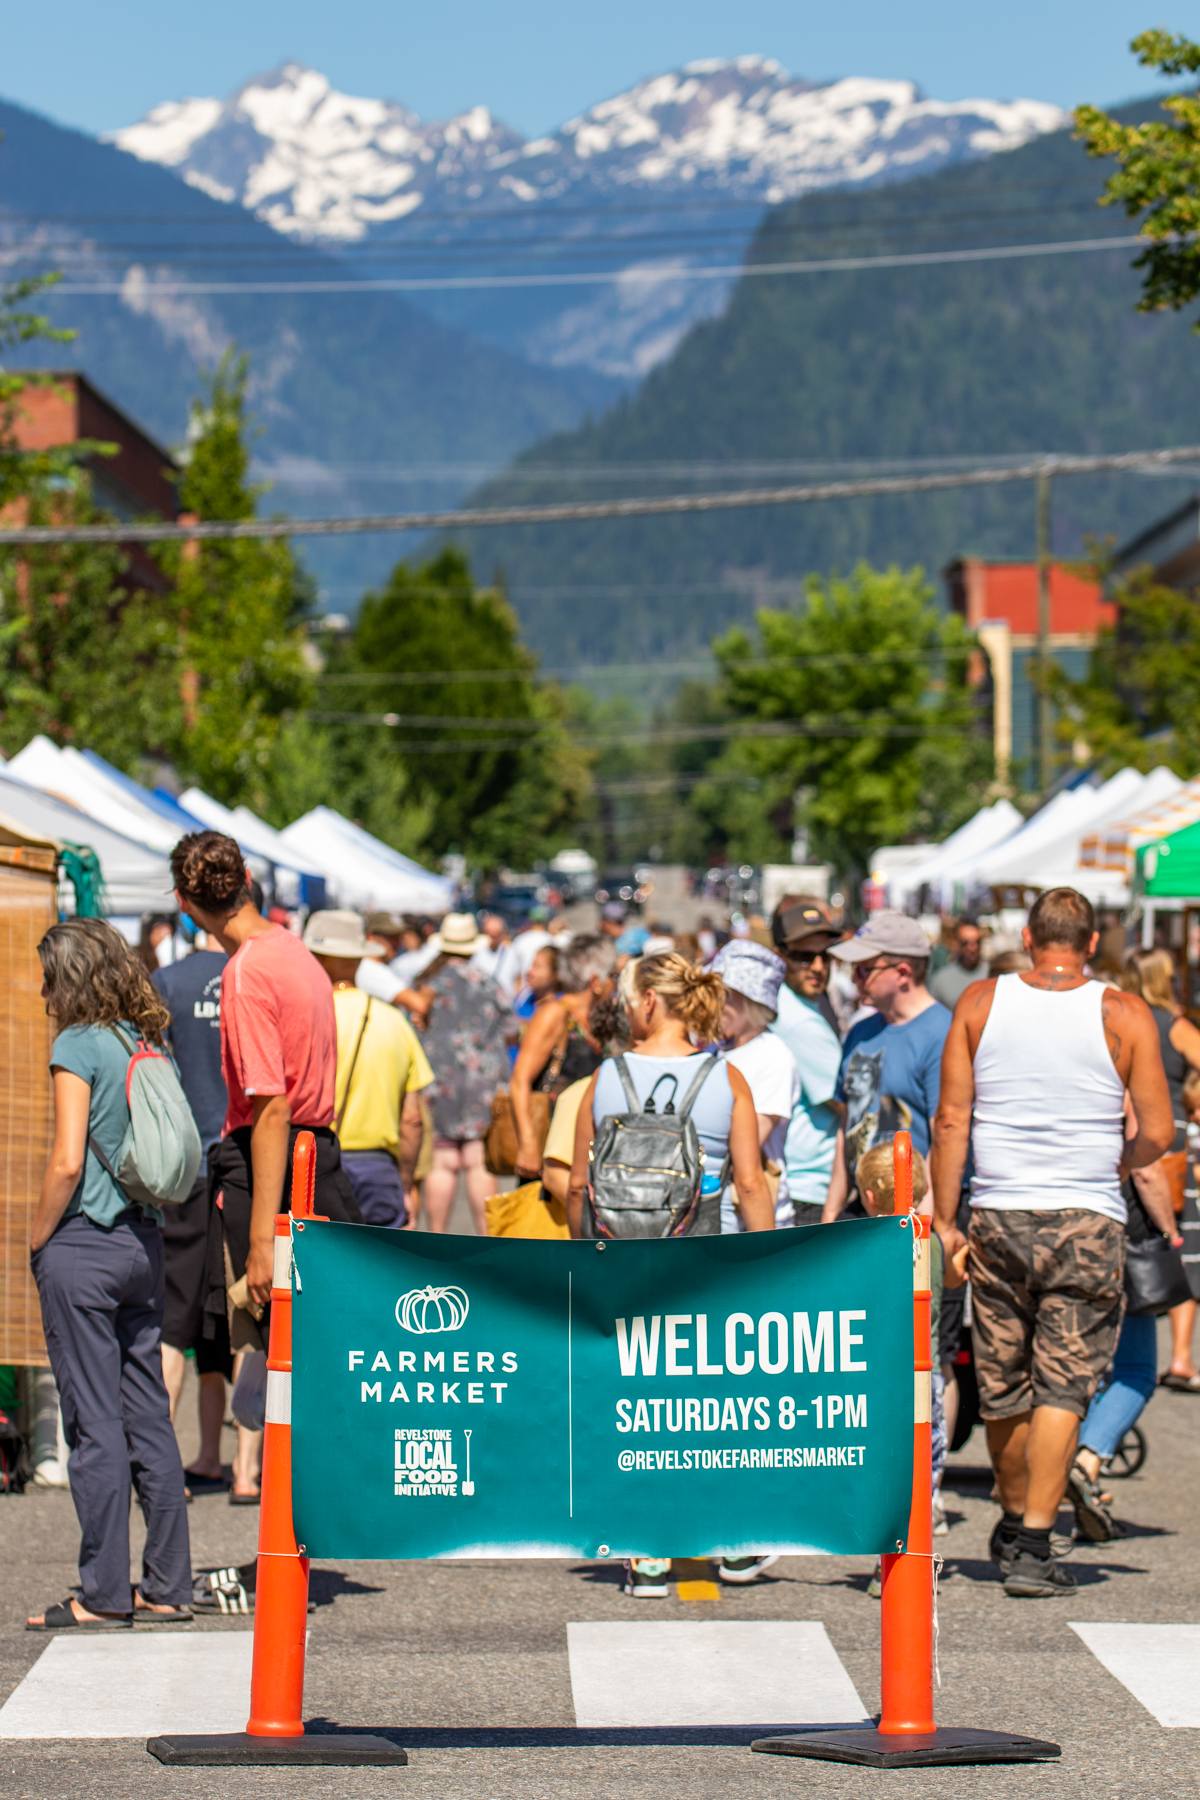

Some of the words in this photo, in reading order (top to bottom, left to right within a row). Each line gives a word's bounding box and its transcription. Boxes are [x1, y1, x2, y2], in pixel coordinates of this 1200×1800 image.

[615, 1310, 868, 1377] WELCOME
[348, 1350, 518, 1374] FARMERS
[360, 1382, 508, 1404] MARKET
[615, 1397, 771, 1433] SATURDAYS
[778, 1394, 868, 1430] 8-1PM
[394, 1429, 452, 1441] REVELSTOKE
[394, 1440, 458, 1470] LOCAL
[617, 1446, 867, 1472] @REVELSTOKEFARMERSMARKET
[394, 1470, 458, 1484] FOOD
[394, 1484, 458, 1497] INITIATIVE
